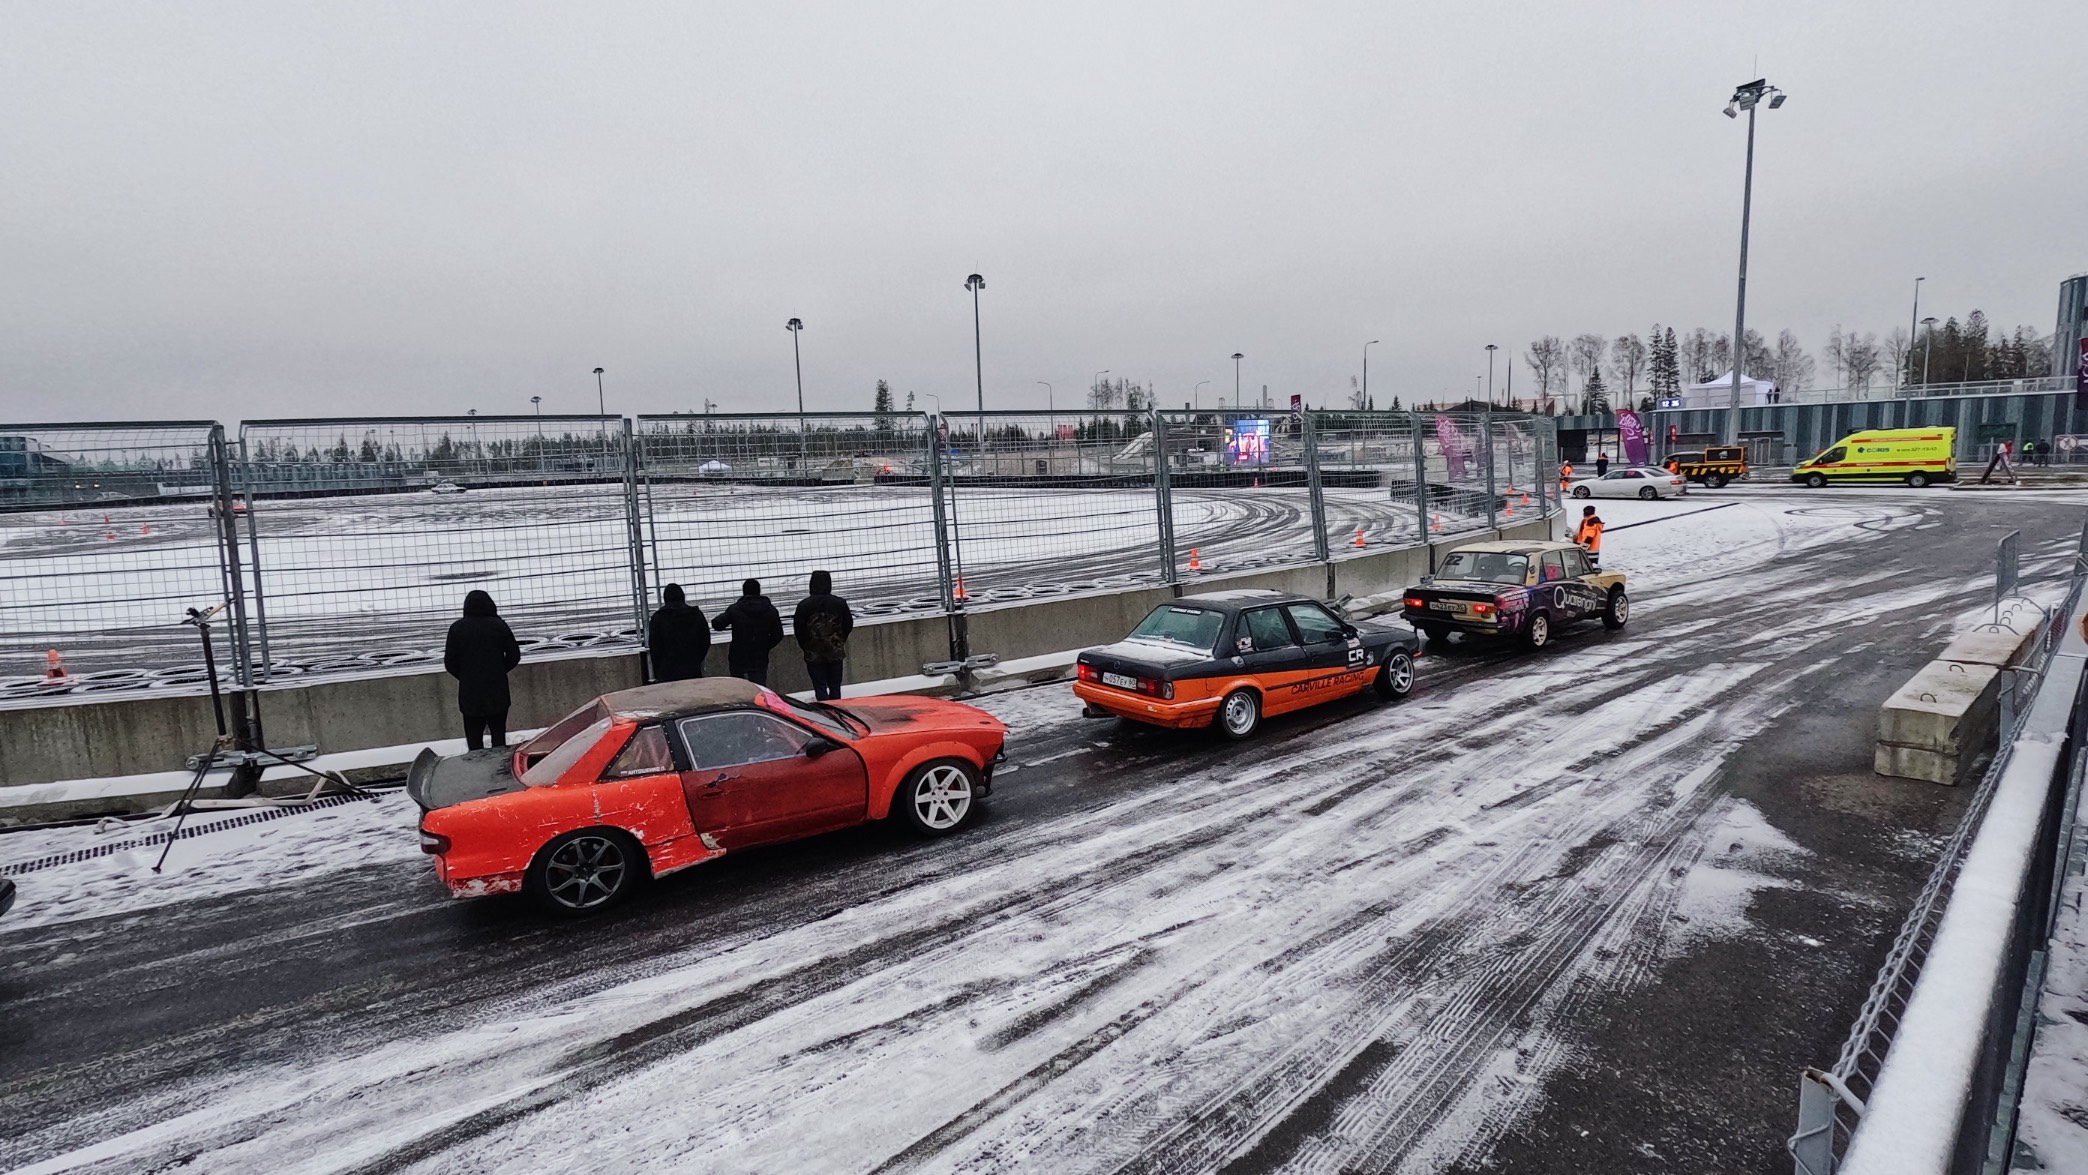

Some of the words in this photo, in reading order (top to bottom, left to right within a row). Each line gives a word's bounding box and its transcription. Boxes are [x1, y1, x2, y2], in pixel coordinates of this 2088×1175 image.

[1444, 556, 1463, 566] 22
[1348, 648, 1364, 662] CR
[1291, 678, 1332, 695] CARVILLE
[1333, 672, 1364, 686] RACING
